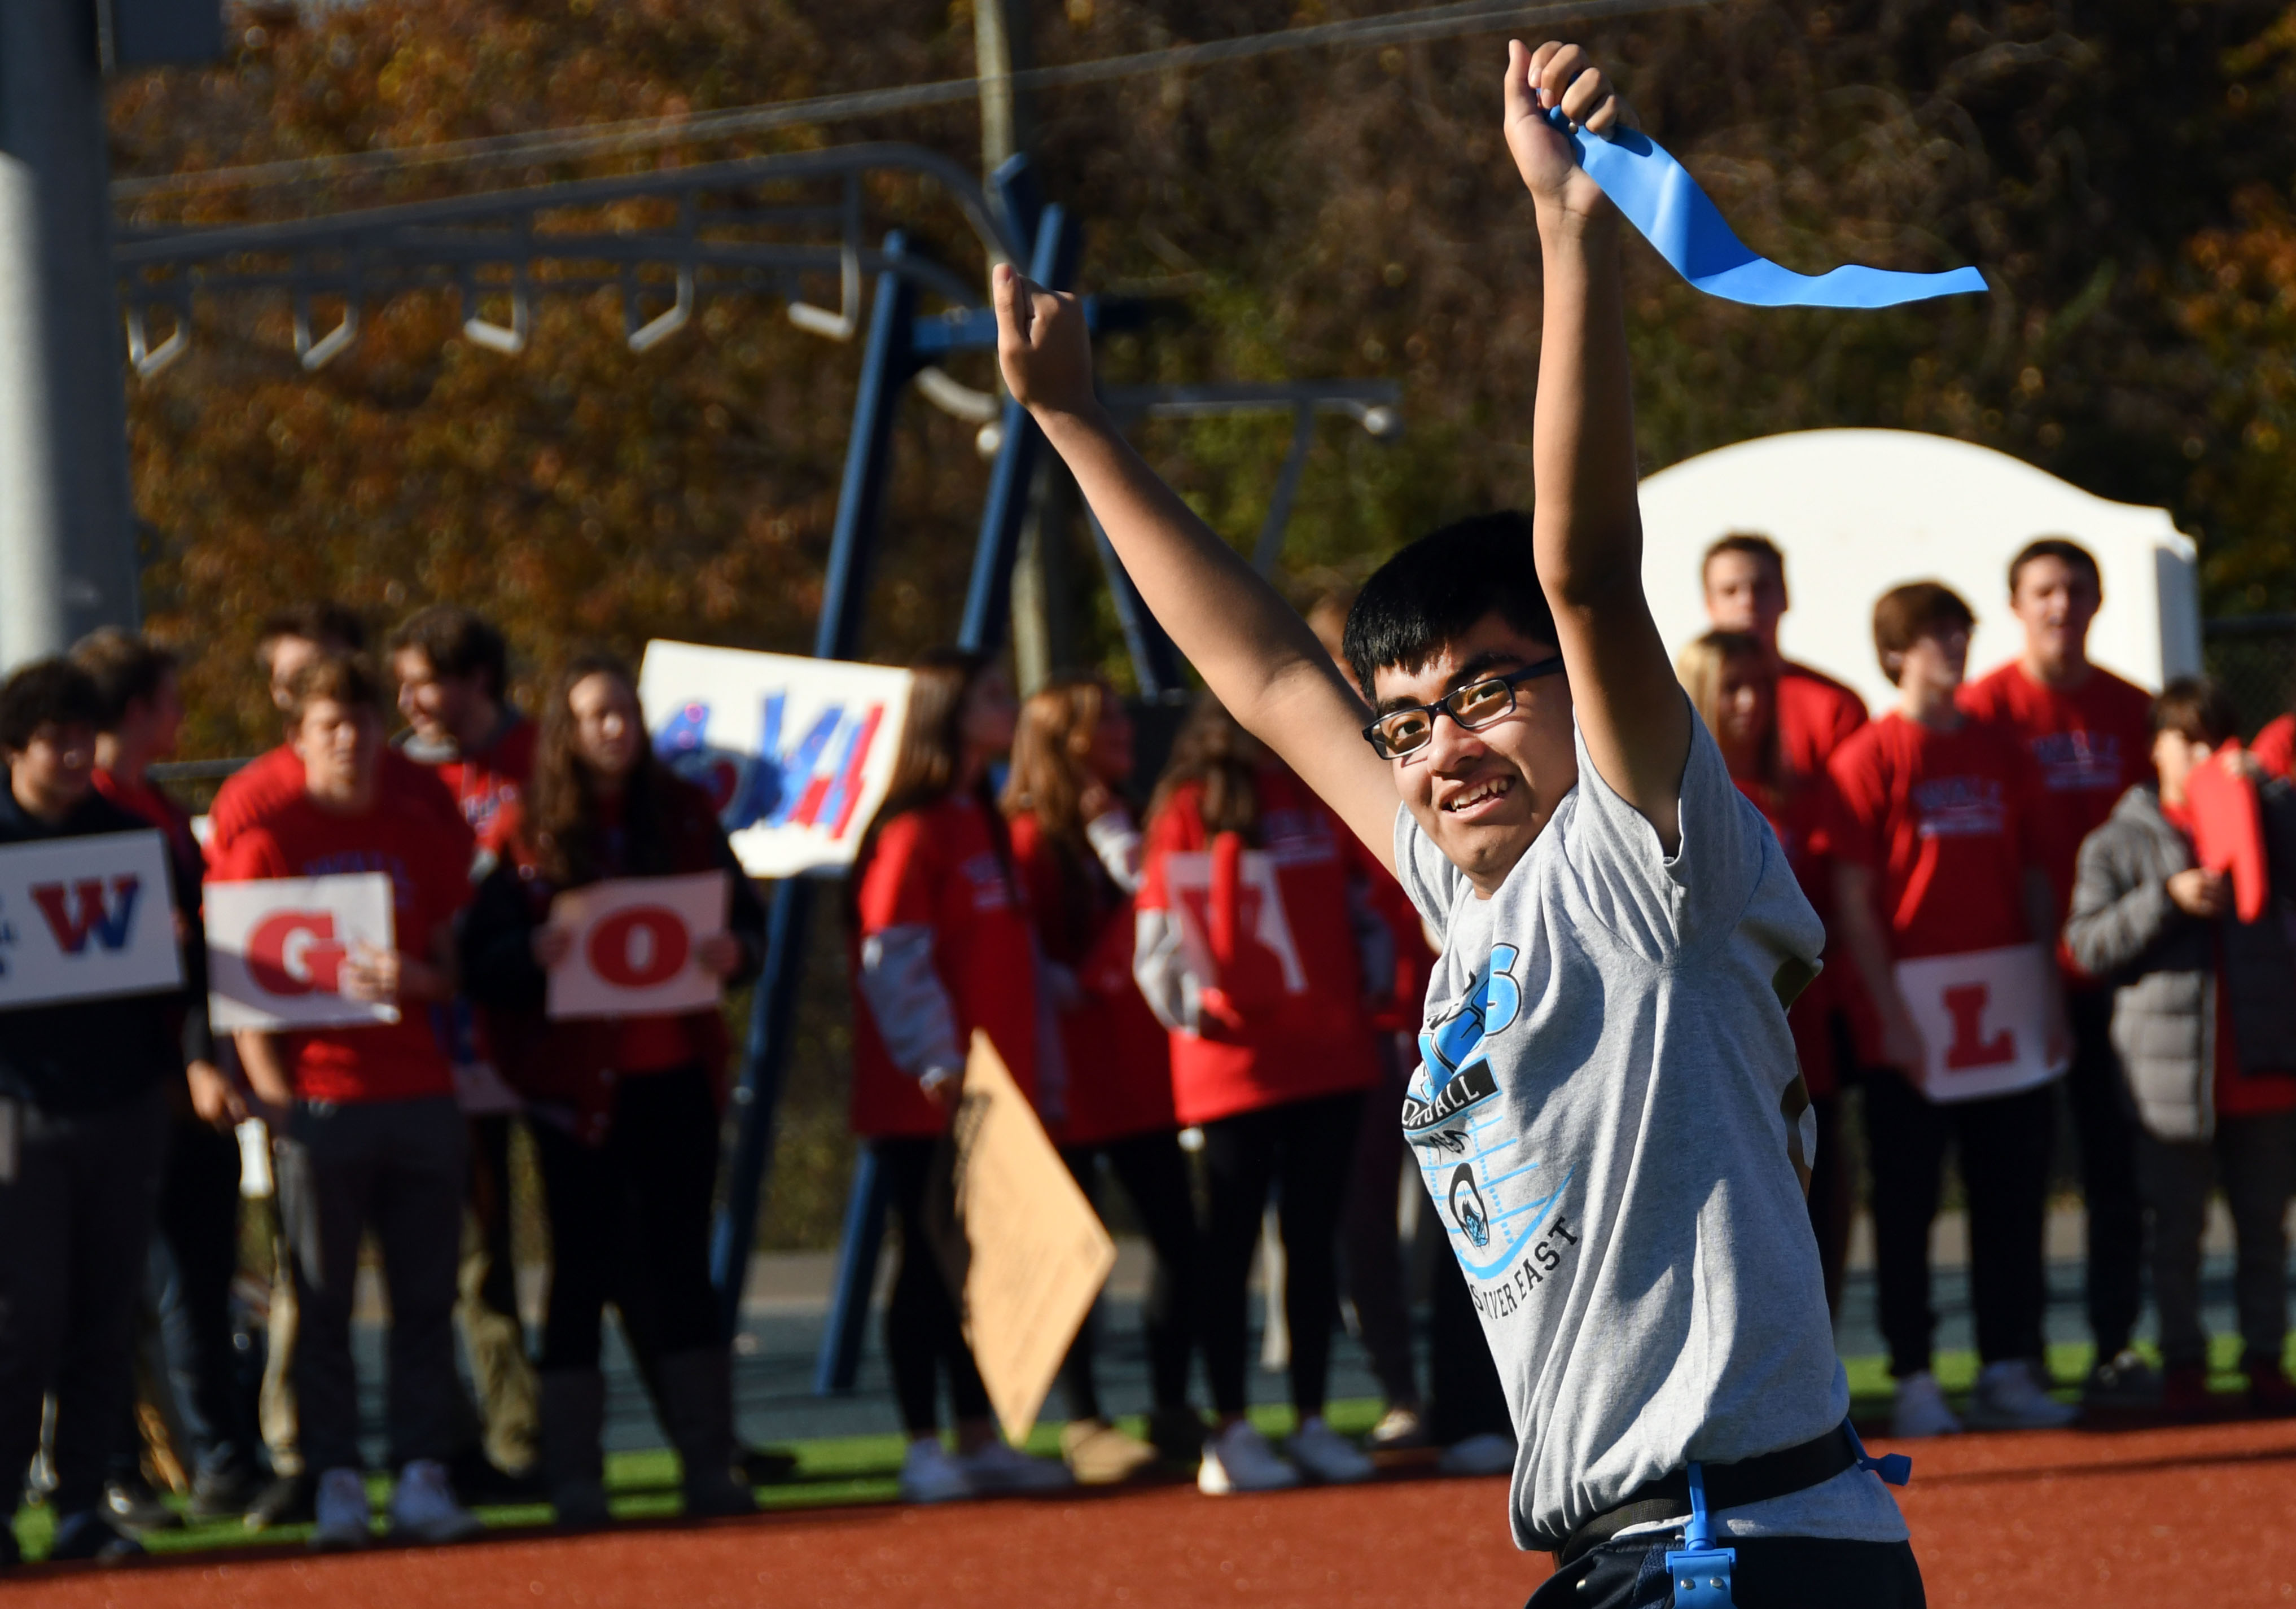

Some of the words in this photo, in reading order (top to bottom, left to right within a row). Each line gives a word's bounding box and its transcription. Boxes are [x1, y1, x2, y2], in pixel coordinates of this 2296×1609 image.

[30, 873, 141, 955] W
[245, 909, 347, 997] G
[587, 906, 689, 989] O
[1942, 984, 2015, 1070] L
[1514, 1216, 1578, 1301] EAST
